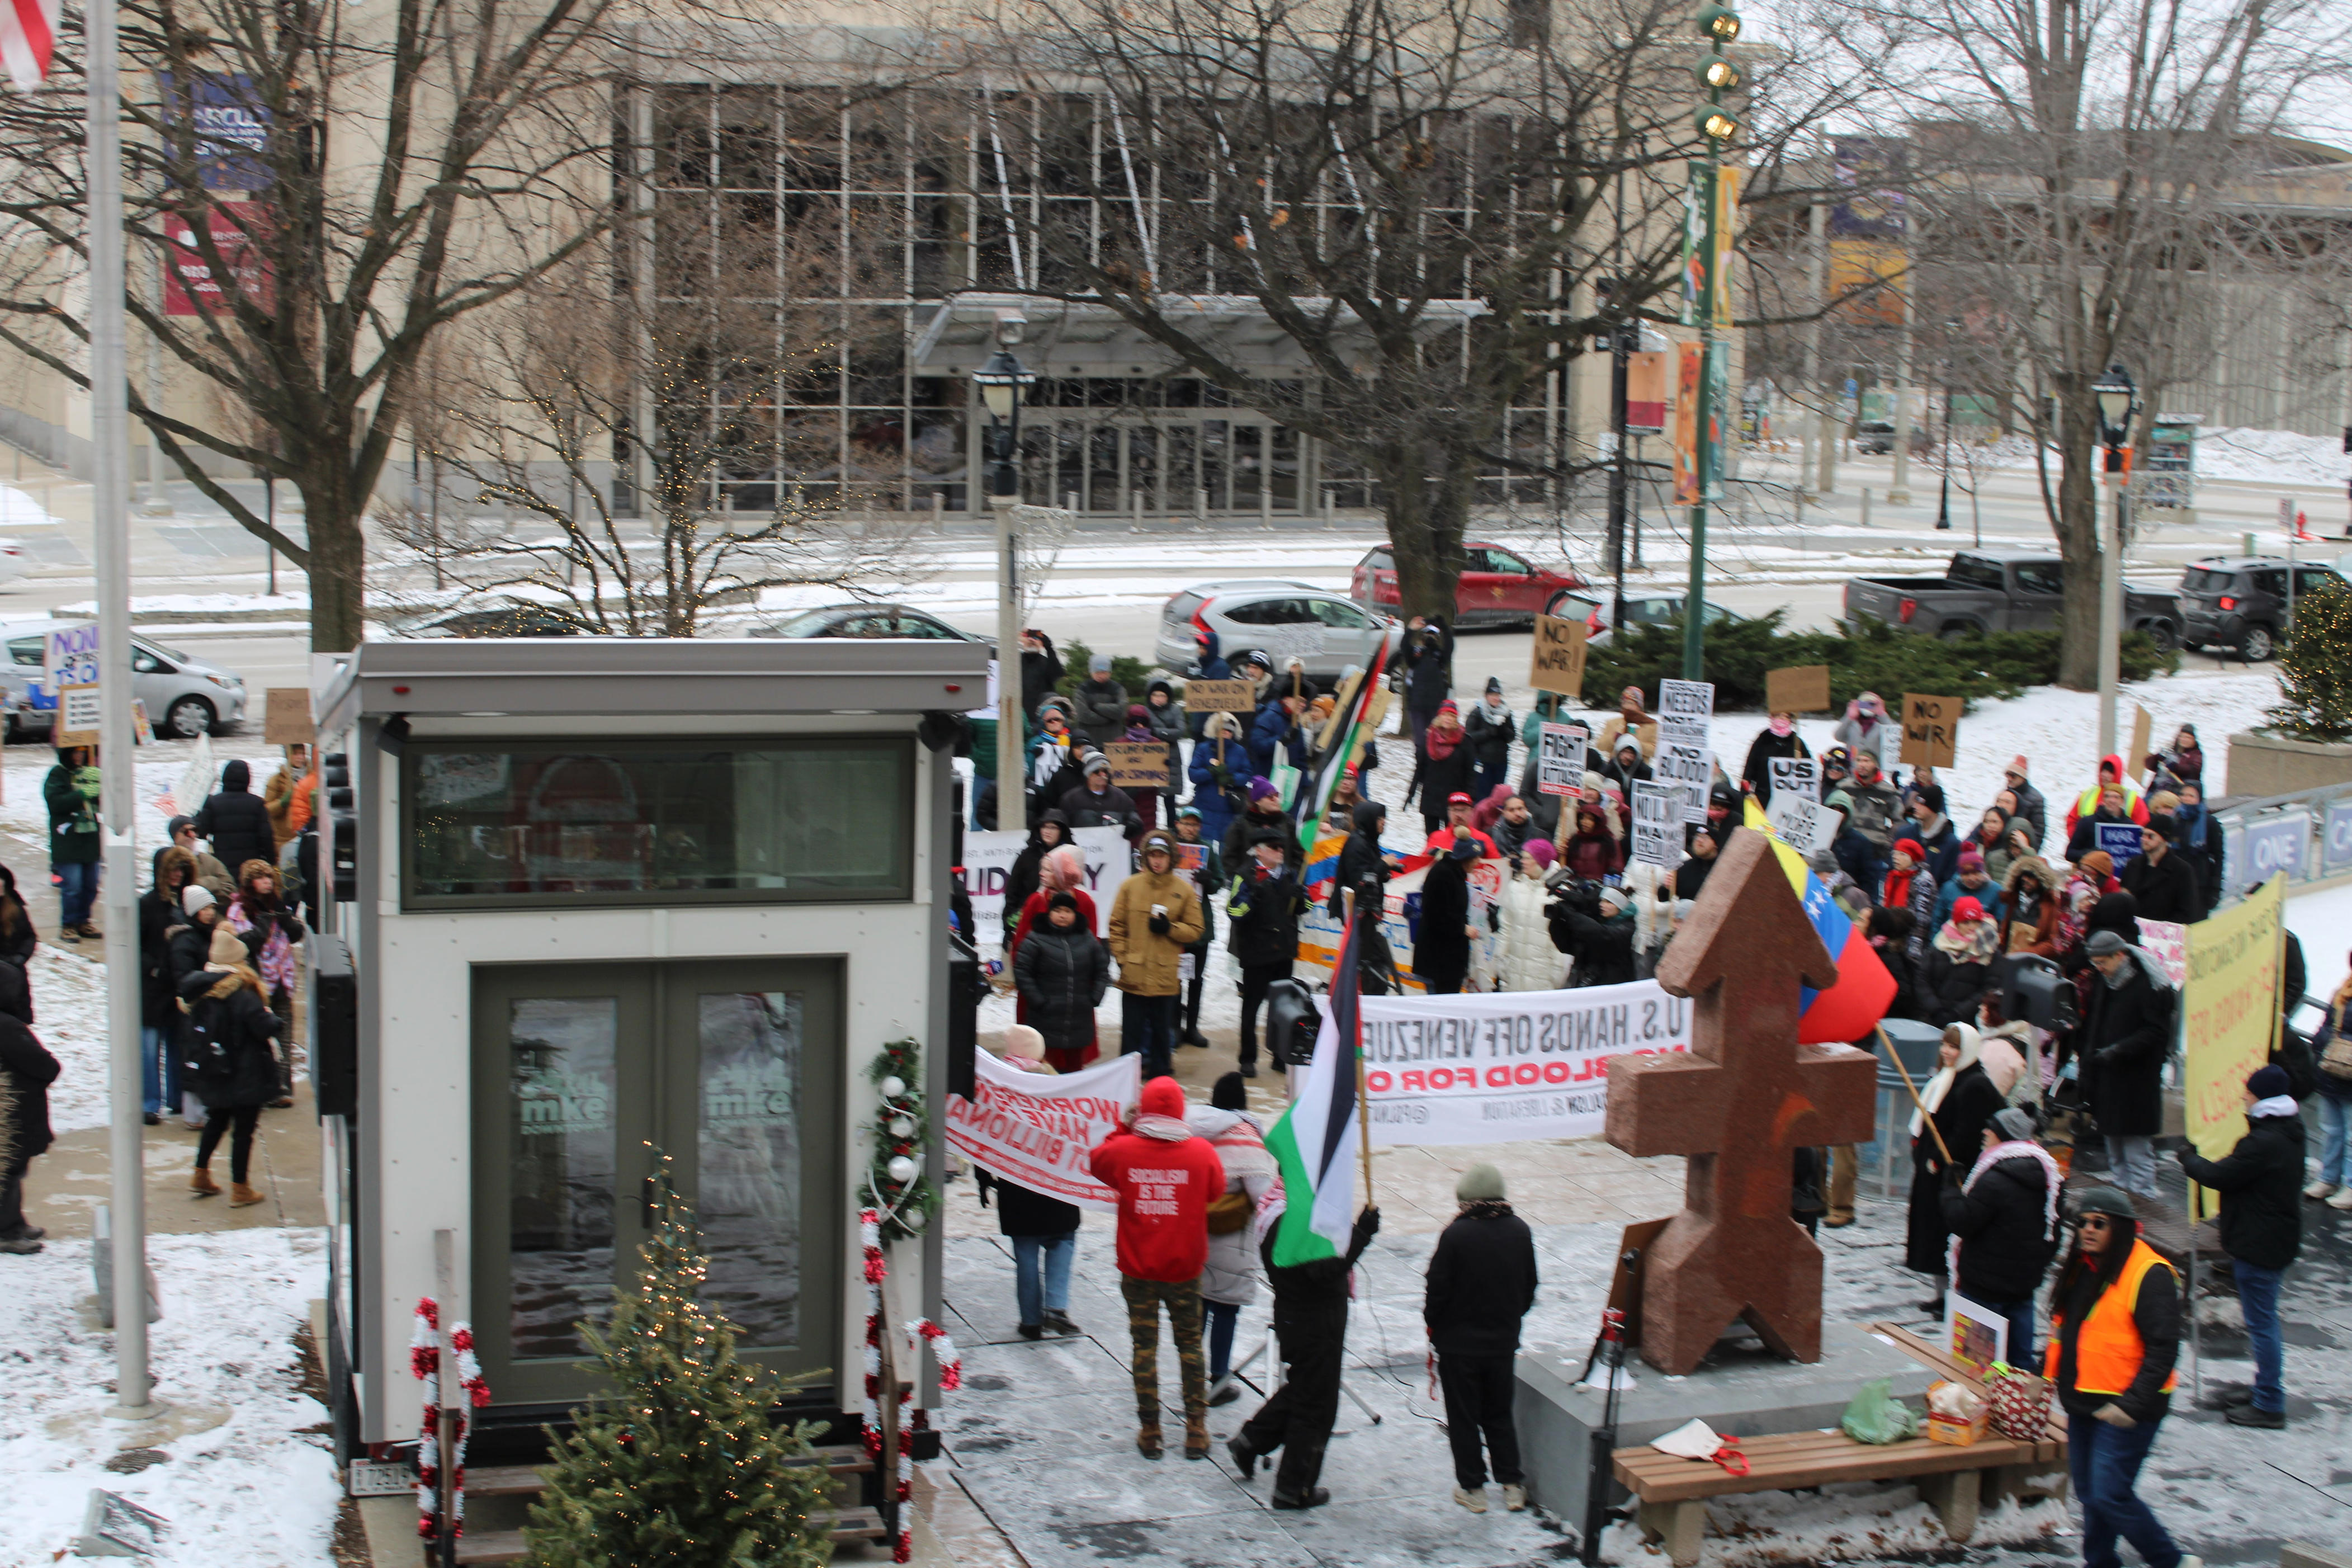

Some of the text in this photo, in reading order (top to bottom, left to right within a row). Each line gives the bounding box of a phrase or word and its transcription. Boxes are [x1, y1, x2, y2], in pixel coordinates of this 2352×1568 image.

[53, 625, 99, 655] NON
[1543, 621, 1571, 644] NO
[1535, 645, 1580, 673] WAR!
[1912, 701, 1942, 719] NO
[1905, 722, 1957, 750] WAR!
[1670, 745, 1701, 759] NO
[1659, 755, 1709, 783] BLOOD
[1774, 761, 1814, 778] US
[1775, 779, 1815, 792] OUT
[1793, 799, 1817, 820] NO
[1775, 810, 1818, 838] MORE
[2255, 834, 2296, 870] ONE
[521, 1093, 608, 1122] mke
[707, 1088, 792, 1116] mke
[1128, 1168, 1189, 1184] SOCIALISM
[1139, 1184, 1176, 1199] IS THE
[1134, 1199, 1179, 1216] FUTURE
